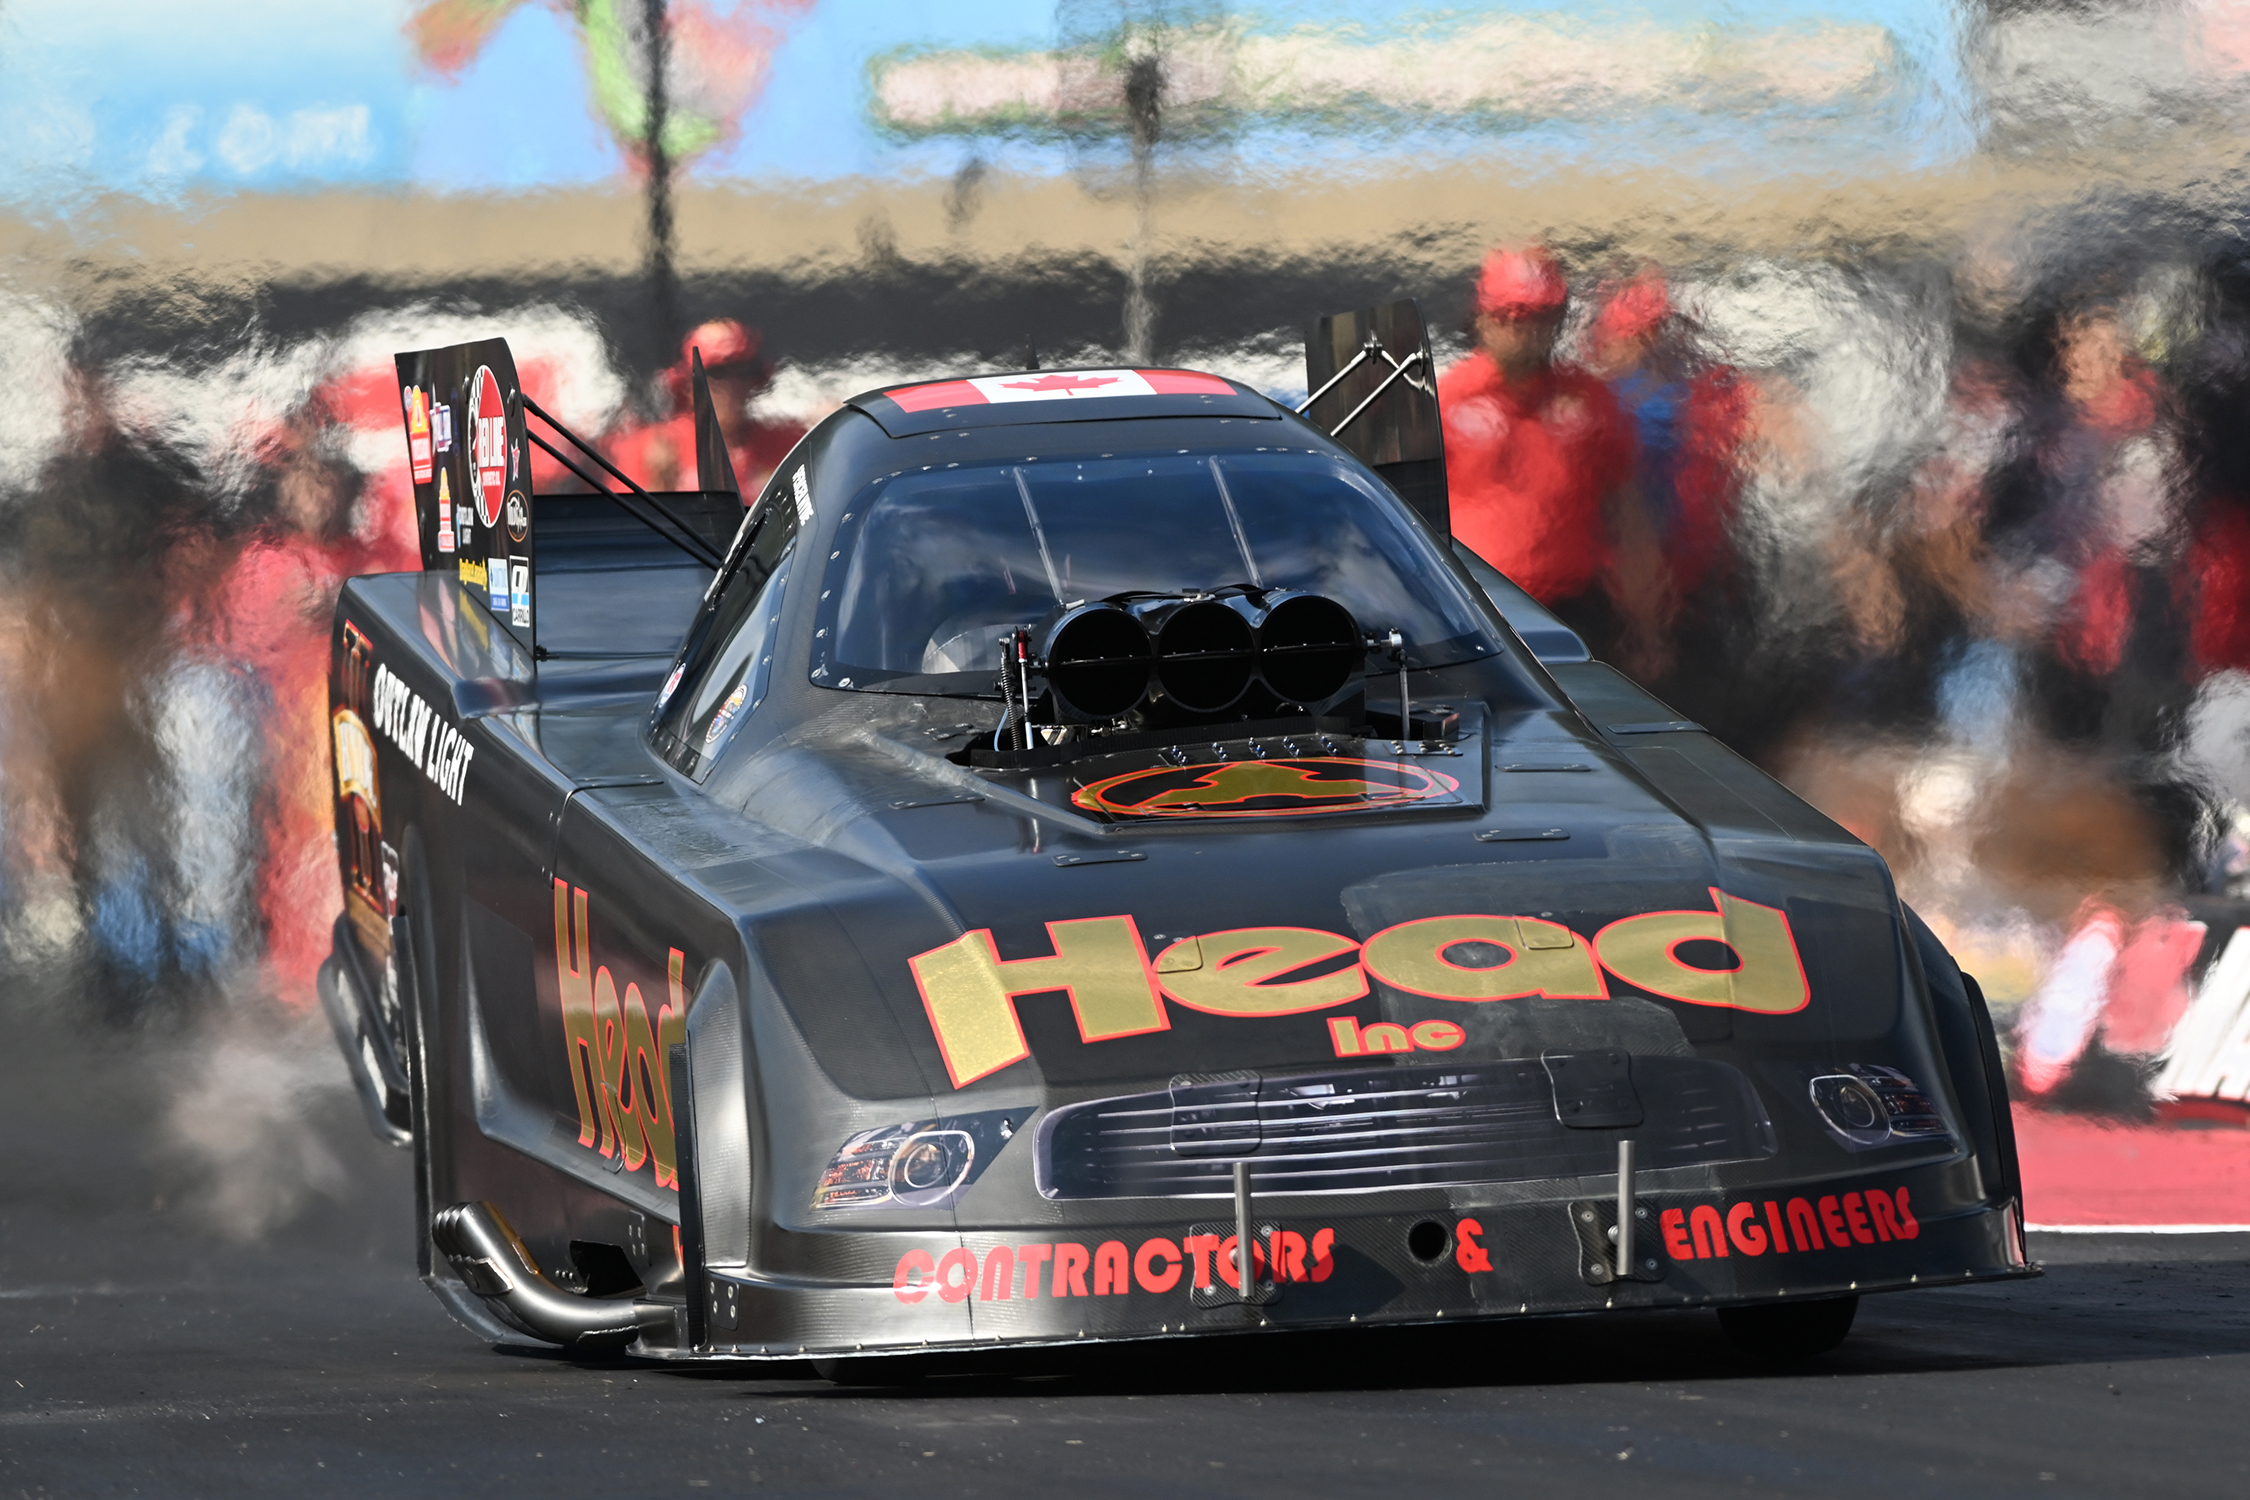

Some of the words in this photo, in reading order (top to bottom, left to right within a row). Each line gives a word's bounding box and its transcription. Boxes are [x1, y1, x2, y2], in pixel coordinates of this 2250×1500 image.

[478, 417, 490, 468] RED
[490, 416, 505, 467] LINE
[373, 662, 433, 770] OUTLAW
[426, 713, 475, 806] LIGHT
[554, 877, 686, 1191] Head
[907, 886, 1811, 1090] Head
[1326, 1016, 1466, 1057] Inc
[892, 1227, 1335, 1305] CONTRACTORS
[1455, 1217, 1494, 1273] &
[1659, 1186, 1919, 1261] ENGINEERS
